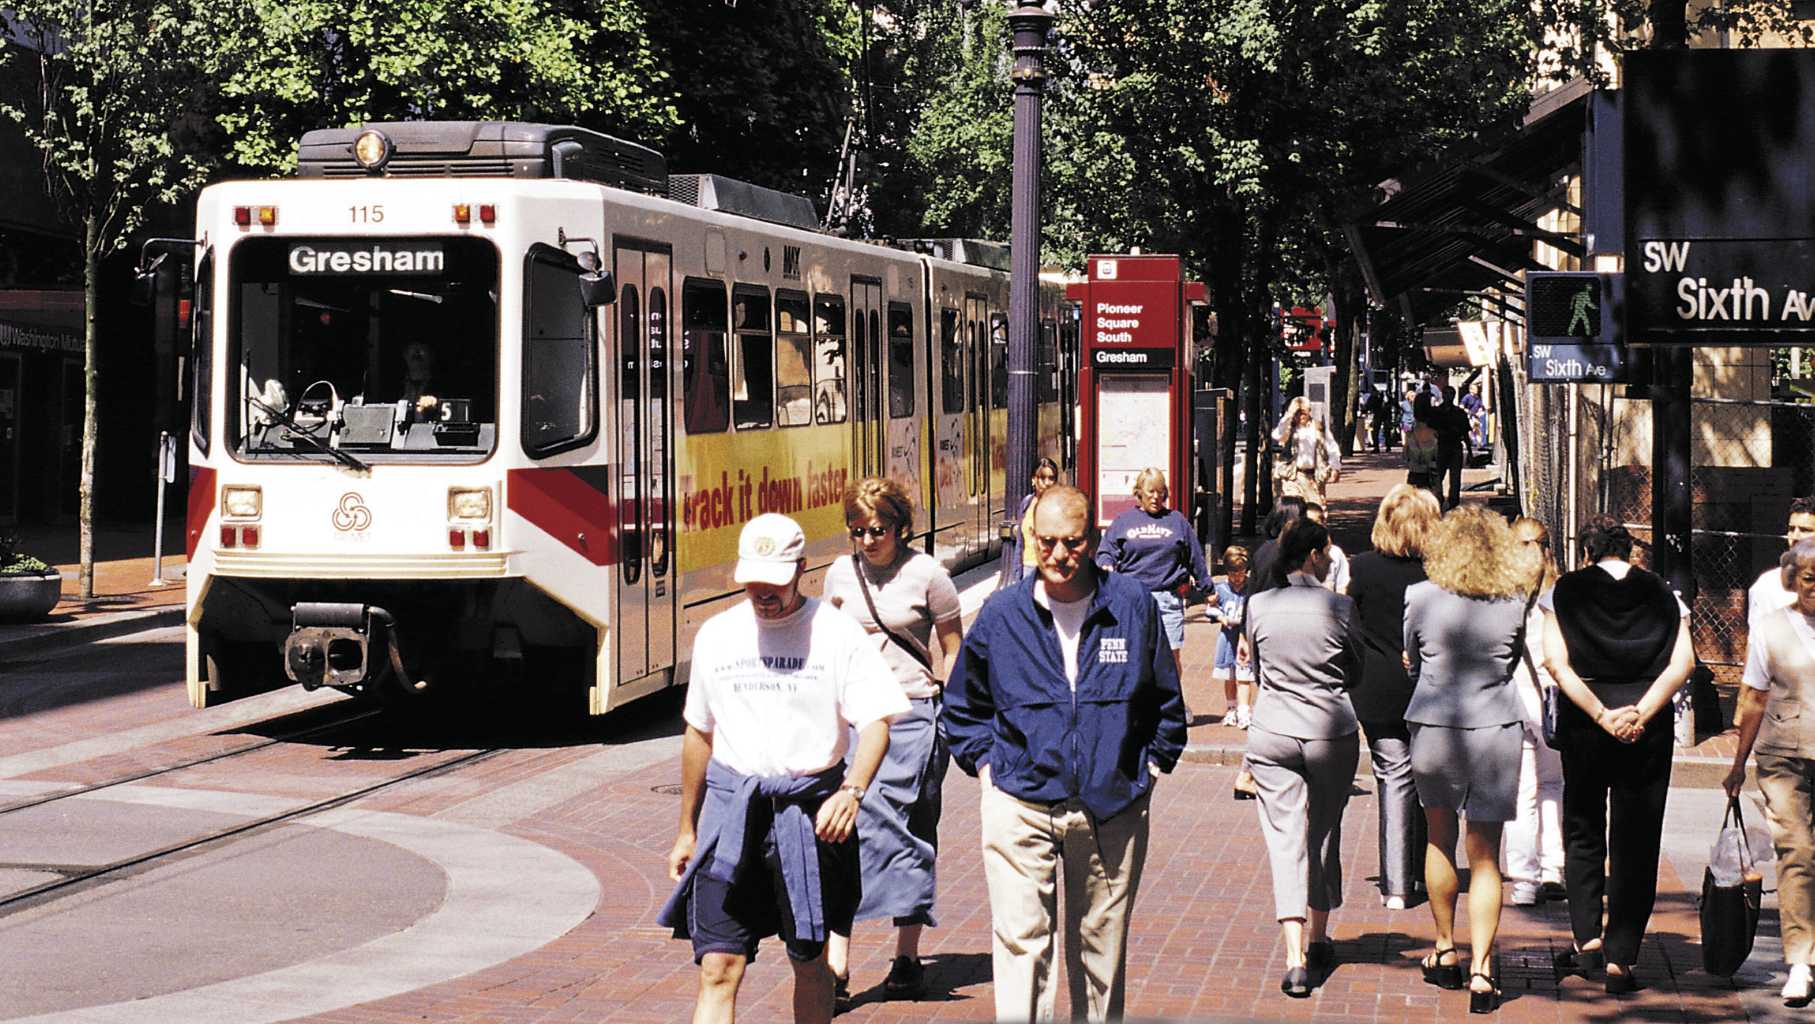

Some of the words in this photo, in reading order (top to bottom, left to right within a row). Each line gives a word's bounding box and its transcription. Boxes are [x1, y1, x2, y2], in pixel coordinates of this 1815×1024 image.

[349, 205, 385, 223] 115
[289, 245, 444, 273] Gresham
[1643, 241, 1691, 273] SW
[1676, 276, 1770, 320] Sixth
[1096, 302, 1143, 314] Pioneer
[1096, 317, 1139, 331] Square
[1096, 331, 1132, 343] South
[1096, 351, 1148, 364] Gresham
[1533, 344, 1552, 359] SW
[1545, 359, 1582, 377] Sixth
[1585, 363, 1607, 376] Ave
[739, 469, 753, 523] it
[758, 466, 803, 514] down
[807, 460, 848, 510] faster
[1100, 638, 1126, 650] PENN
[1099, 650, 1128, 663] STATE
